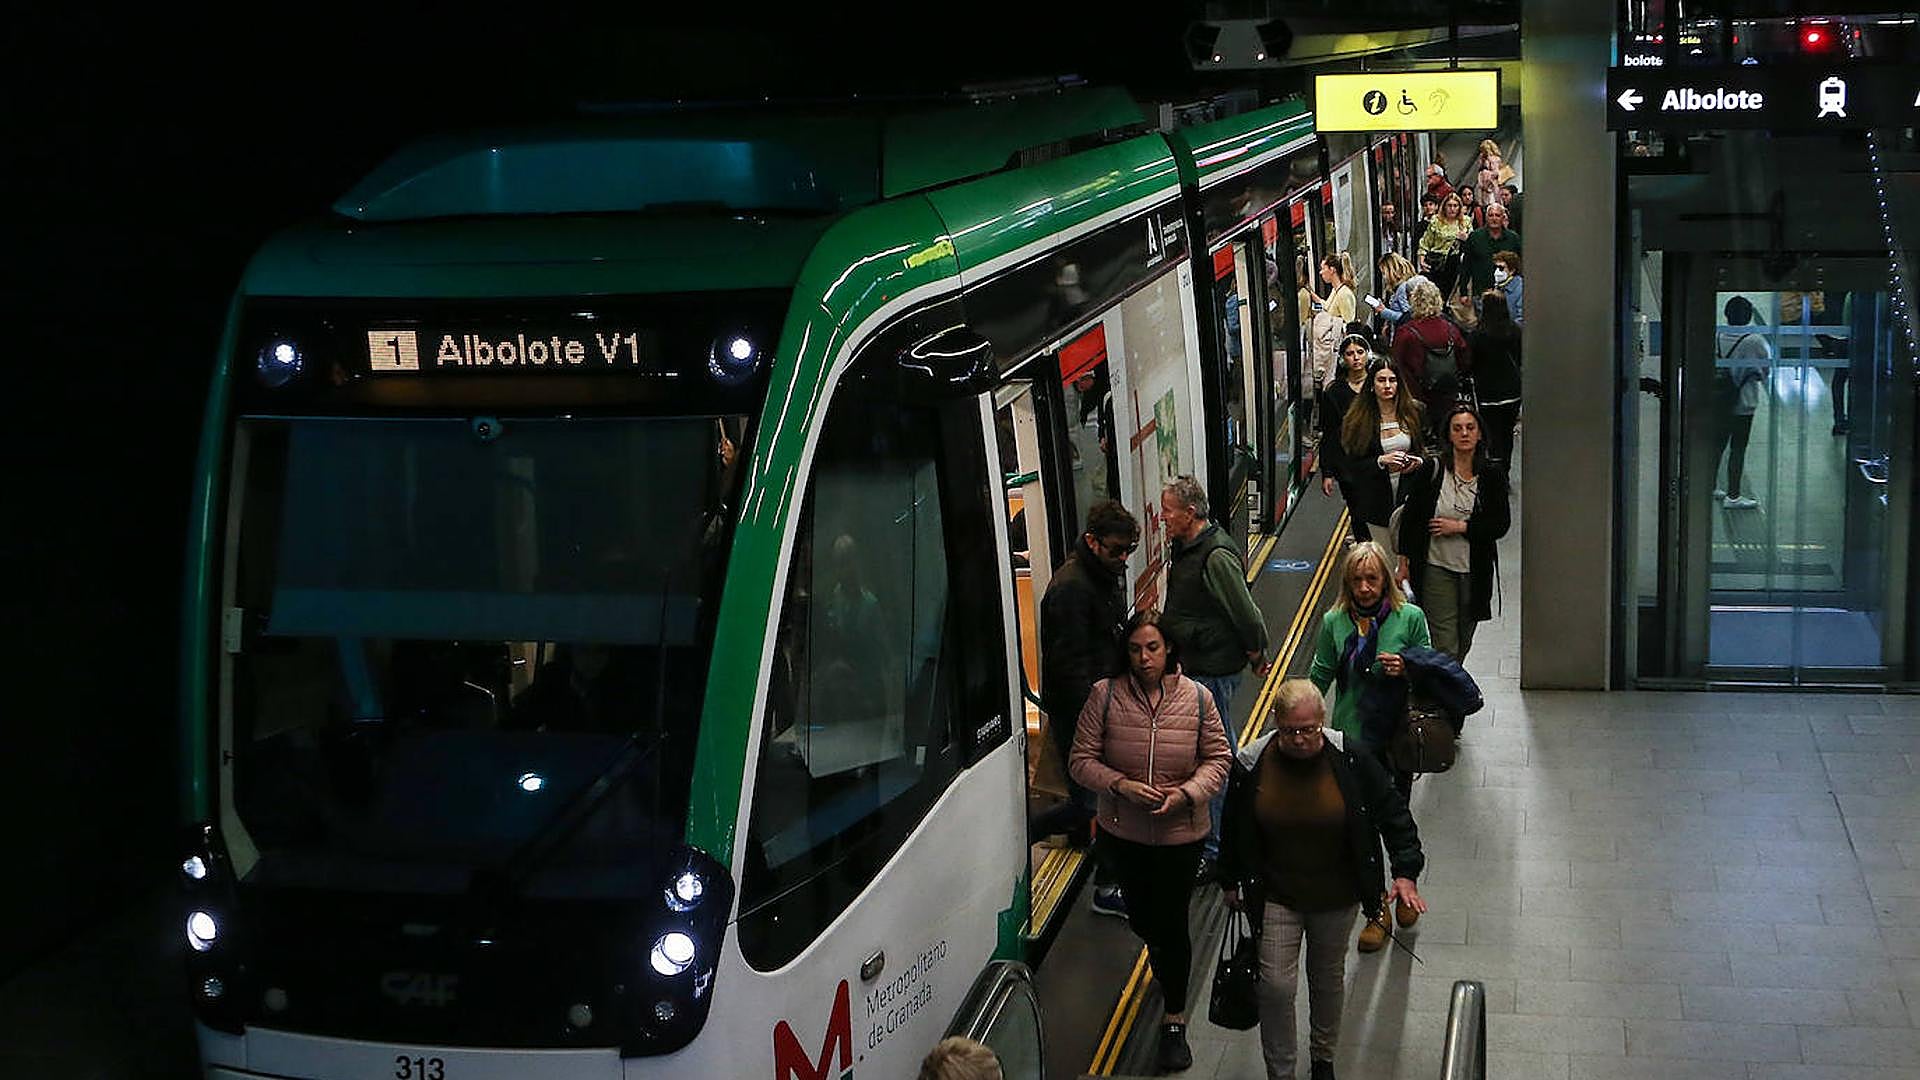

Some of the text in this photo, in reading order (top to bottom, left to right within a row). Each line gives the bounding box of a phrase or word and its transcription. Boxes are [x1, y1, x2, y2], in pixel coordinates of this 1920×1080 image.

[1661, 87, 1764, 111] Albolote
[436, 333, 586, 366] Albolote
[595, 332, 639, 365] V1
[866, 939, 948, 1018] Metropolitano
[868, 982, 933, 1050] de Granada
[395, 1055, 445, 1080] 313
